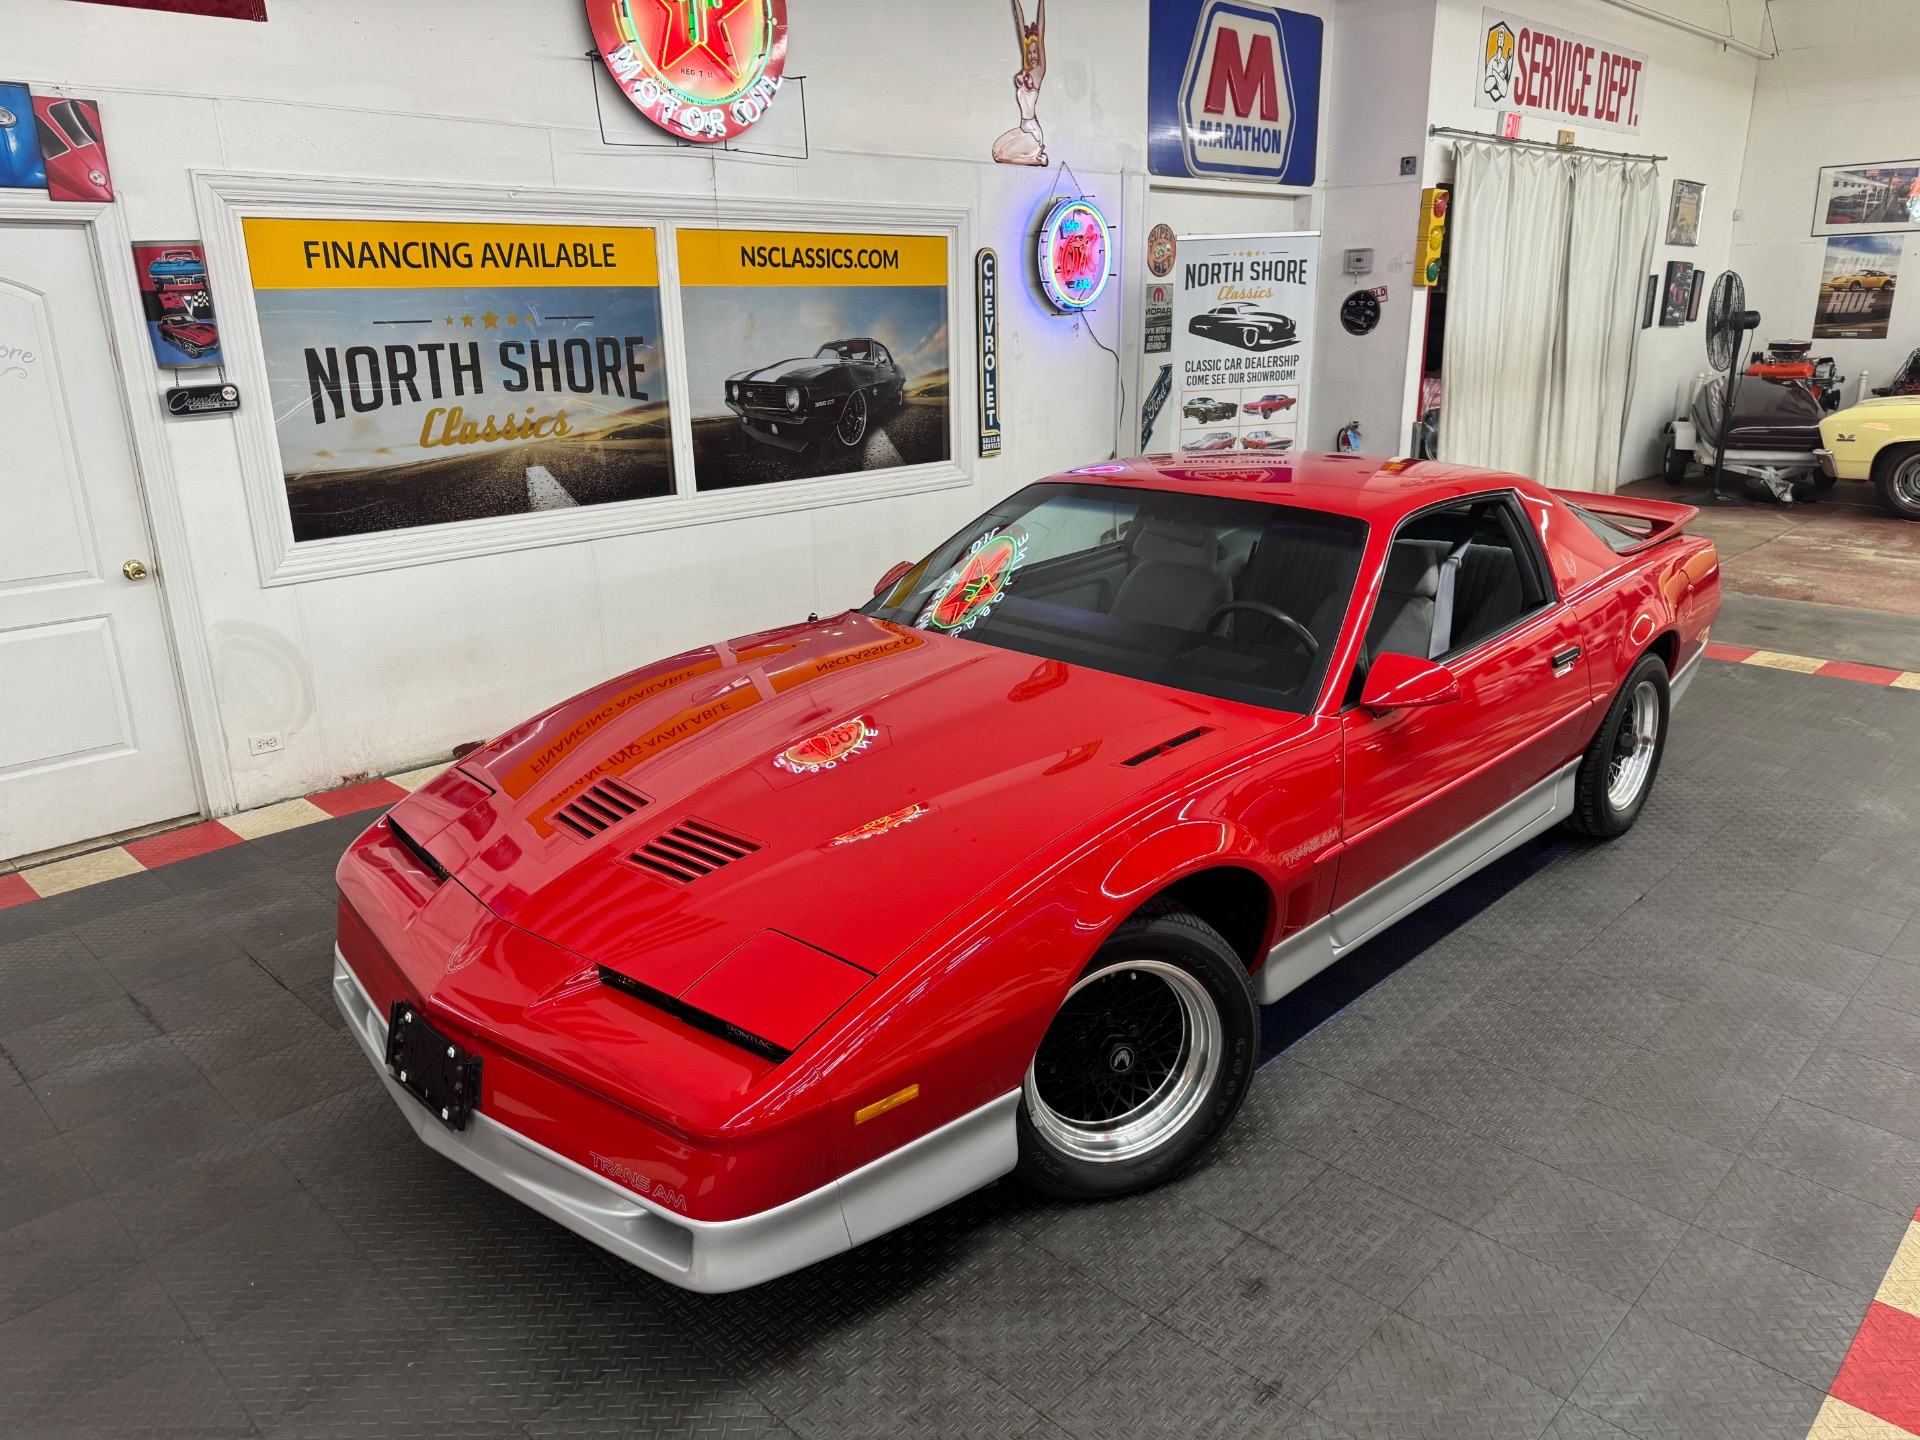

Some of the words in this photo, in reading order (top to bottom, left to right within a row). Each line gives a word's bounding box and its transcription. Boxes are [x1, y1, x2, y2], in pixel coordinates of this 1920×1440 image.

[605, 43, 727, 138] MOTOR
[729, 75, 783, 127] OIL
[1513, 27, 1595, 117] SERVICE
[1594, 51, 1642, 127] DEPT.
[1198, 120, 1282, 154] MARATHON
[1505, 113, 1521, 138] EXIT
[303, 240, 473, 270] FINANCING
[480, 242, 617, 268] AVAILABLE
[740, 246, 899, 269] NSCLASSICS.COM
[1061, 224, 1099, 281] OK
[1153, 255, 1172, 274] BEE
[1185, 261, 1243, 291] NORTH
[1250, 258, 1308, 285] SHORE
[1217, 286, 1274, 301] Classics
[1825, 291, 1879, 314] RIDE
[1145, 307, 1172, 316] MOPAR
[983, 259, 997, 427] CHEVROLET
[1184, 358, 1222, 373] CLASSIC
[1224, 357, 1243, 371] CAR
[1244, 354, 1300, 370] DEALERSHIP
[1186, 374, 1210, 386] COME
[1211, 373, 1227, 385] SEE
[1228, 372, 1245, 384] OUR
[1246, 370, 1296, 383] SHOWROOM!
[304, 341, 484, 425] NORTH
[499, 336, 649, 401] SHORE
[169, 391, 224, 411] Corvette
[419, 406, 574, 449] Classics
[1282, 836, 1320, 866] TRANS
[1320, 826, 1340, 847] AM
[725, 1023, 774, 1051] PONTIAC
[589, 1151, 650, 1193] TRANS
[652, 1184, 688, 1212] AM
